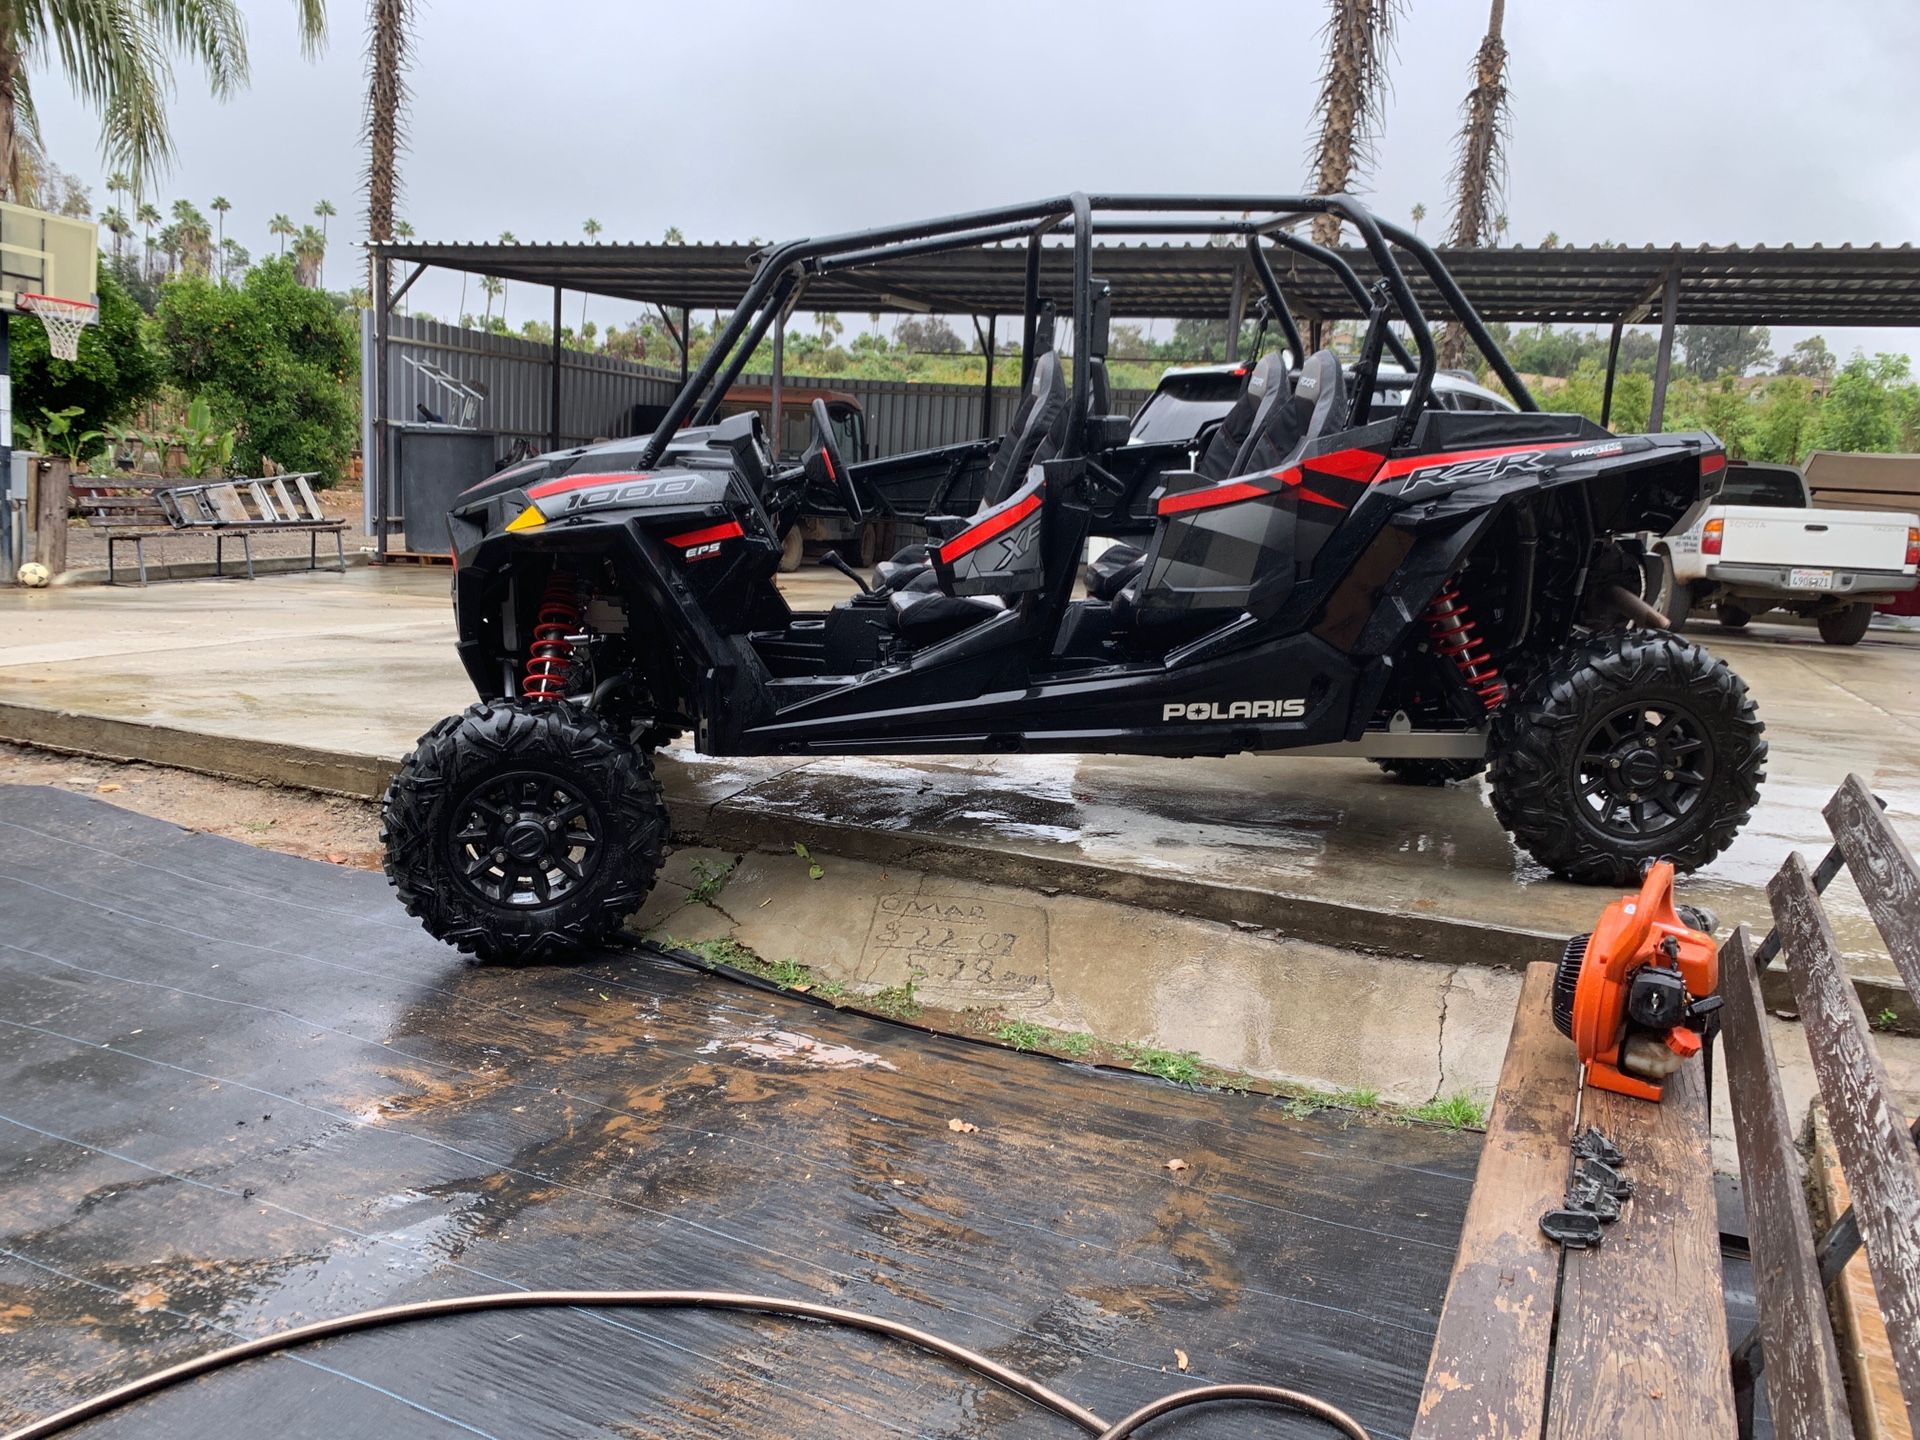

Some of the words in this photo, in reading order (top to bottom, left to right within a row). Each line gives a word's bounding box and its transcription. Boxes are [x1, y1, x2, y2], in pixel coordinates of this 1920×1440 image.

[1398, 450, 1546, 495] RZR
[565, 477, 697, 511] 1000
[1728, 519, 1766, 529] TOYOTA
[685, 541, 722, 558] EPS
[1162, 698, 1306, 722] POLARIS
[882, 896, 988, 919] OMAR
